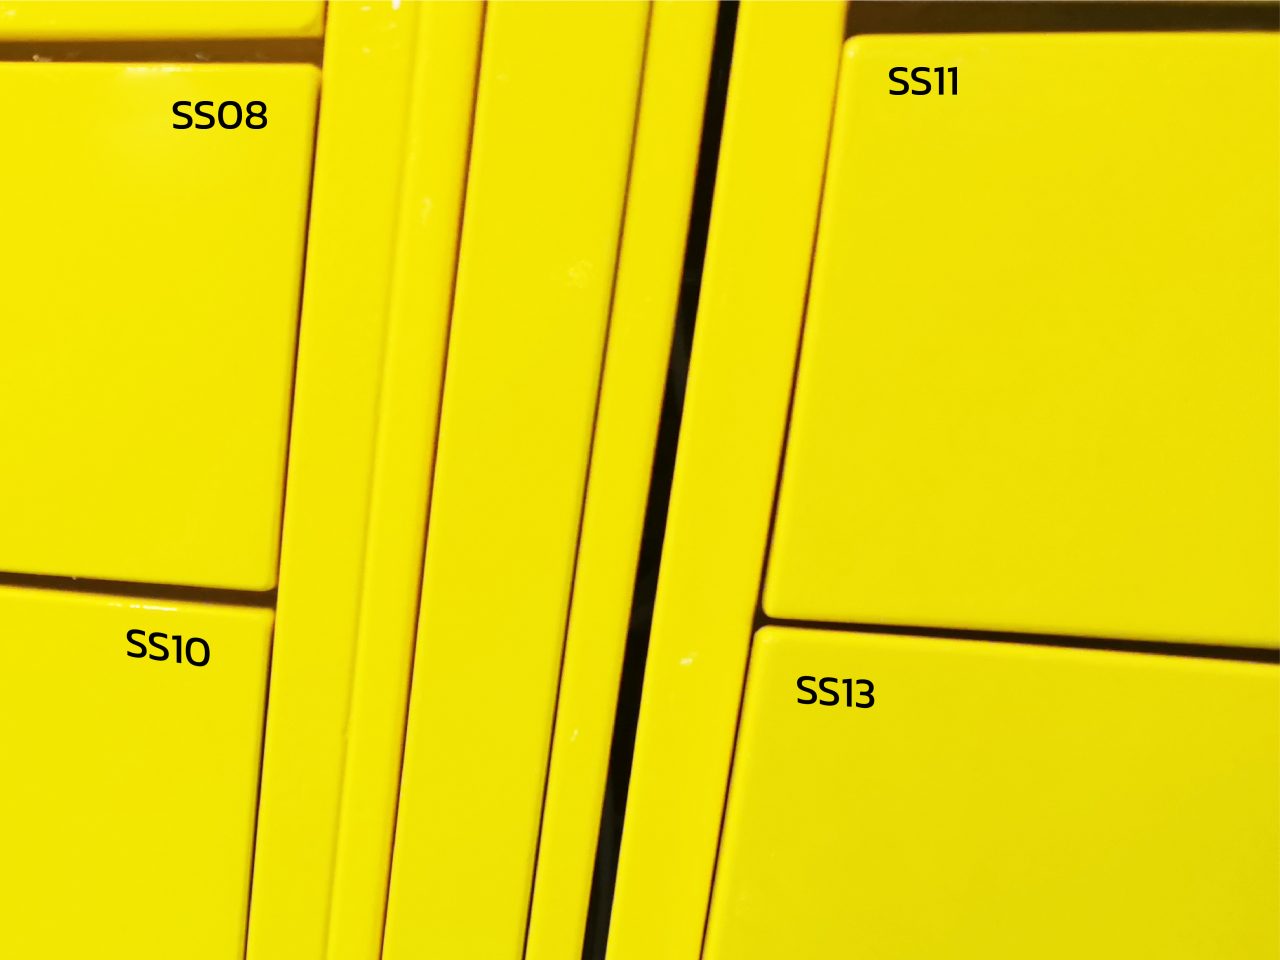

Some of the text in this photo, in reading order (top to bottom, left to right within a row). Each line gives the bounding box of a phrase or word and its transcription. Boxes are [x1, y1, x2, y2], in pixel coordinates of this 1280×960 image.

[888, 66, 958, 96] SS11
[172, 100, 268, 130] SS08
[126, 628, 211, 667] SS10
[796, 675, 875, 709] SS13
